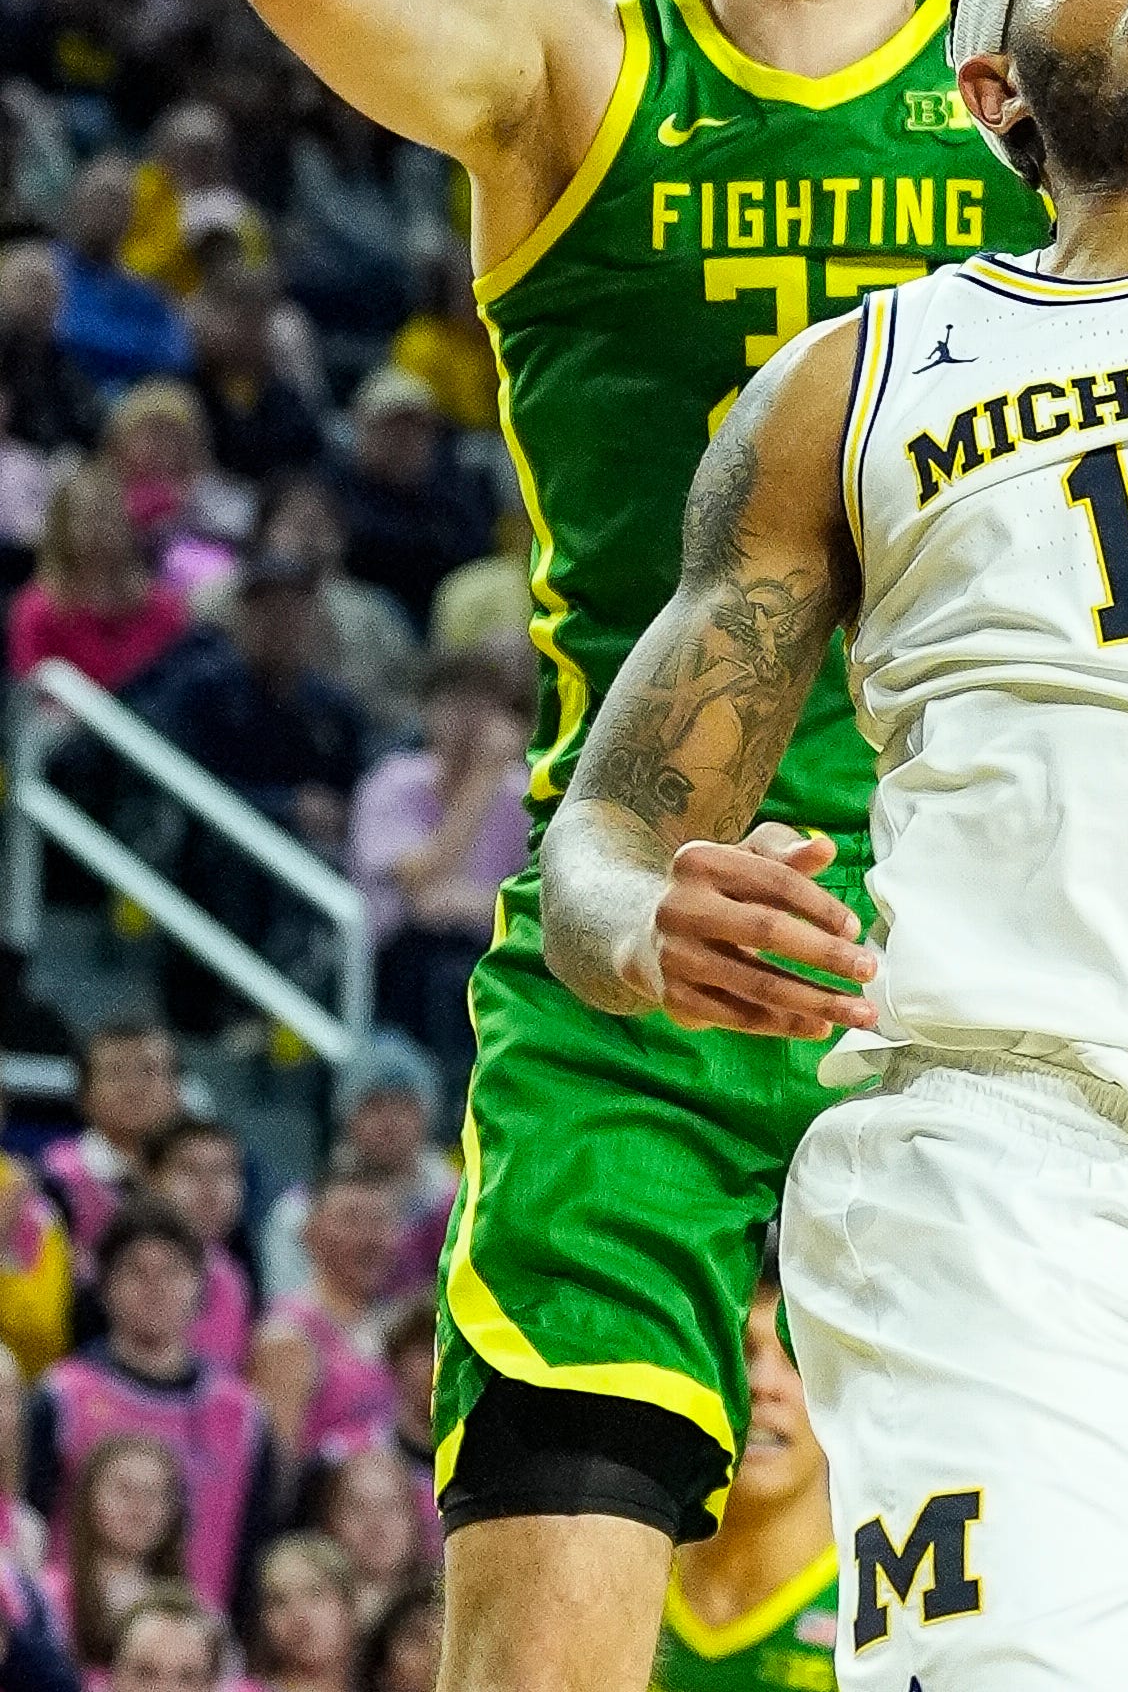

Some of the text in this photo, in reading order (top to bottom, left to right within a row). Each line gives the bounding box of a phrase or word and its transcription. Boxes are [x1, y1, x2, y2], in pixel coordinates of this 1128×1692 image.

[904, 91, 977, 132] BI
[652, 177, 985, 250] FIGHTING
[852, 1486, 985, 1655] M
